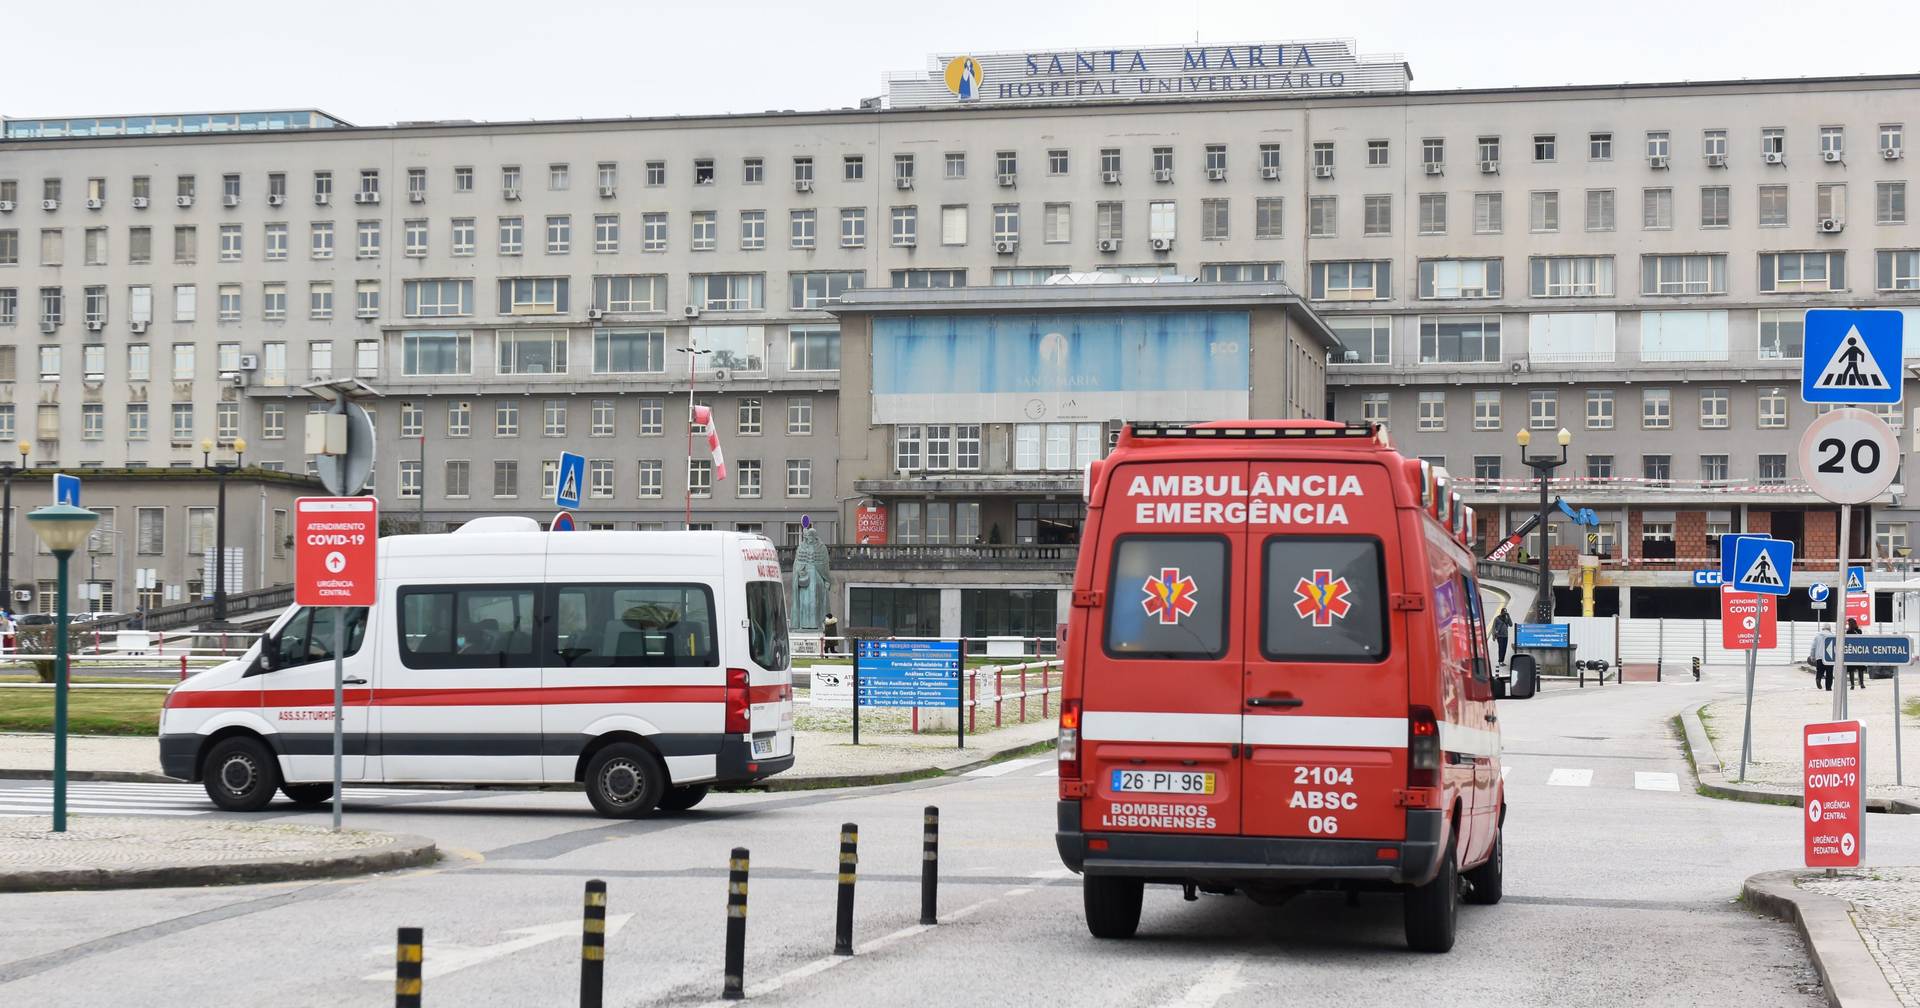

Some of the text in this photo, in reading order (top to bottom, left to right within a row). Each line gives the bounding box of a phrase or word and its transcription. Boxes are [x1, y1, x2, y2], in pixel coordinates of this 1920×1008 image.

[1026, 44, 1314, 76] SANTA MARIA
[1000, 71, 1345, 99] HOSPITAL UNIVERSITÁRIO
[1818, 438, 1880, 474] 20
[1127, 471, 1364, 497] AMBULÂNCIA
[1136, 498, 1349, 524] EMERGÊNCIA
[307, 522, 365, 530] ATENDIMENTO
[307, 534, 365, 545] COVID-19
[316, 579, 354, 587] URGÊNCIA
[1872, 646, 1907, 654] CENTRAL
[1808, 757, 1856, 768] ATENDIMENTO
[1294, 766, 1354, 785] 2104
[1808, 772, 1856, 788] COVID-19
[1289, 791, 1358, 810] ABSC
[1823, 800, 1850, 810] URGÊNCIA
[1111, 802, 1208, 817] BOMBEIROS
[1823, 811, 1847, 820] CENTRAL
[1102, 814, 1217, 829] LISBONENSES
[1308, 815, 1338, 834] 06
[1812, 835, 1839, 845] URGÊNCIA
[1813, 846, 1840, 855] PEDIATRIA
